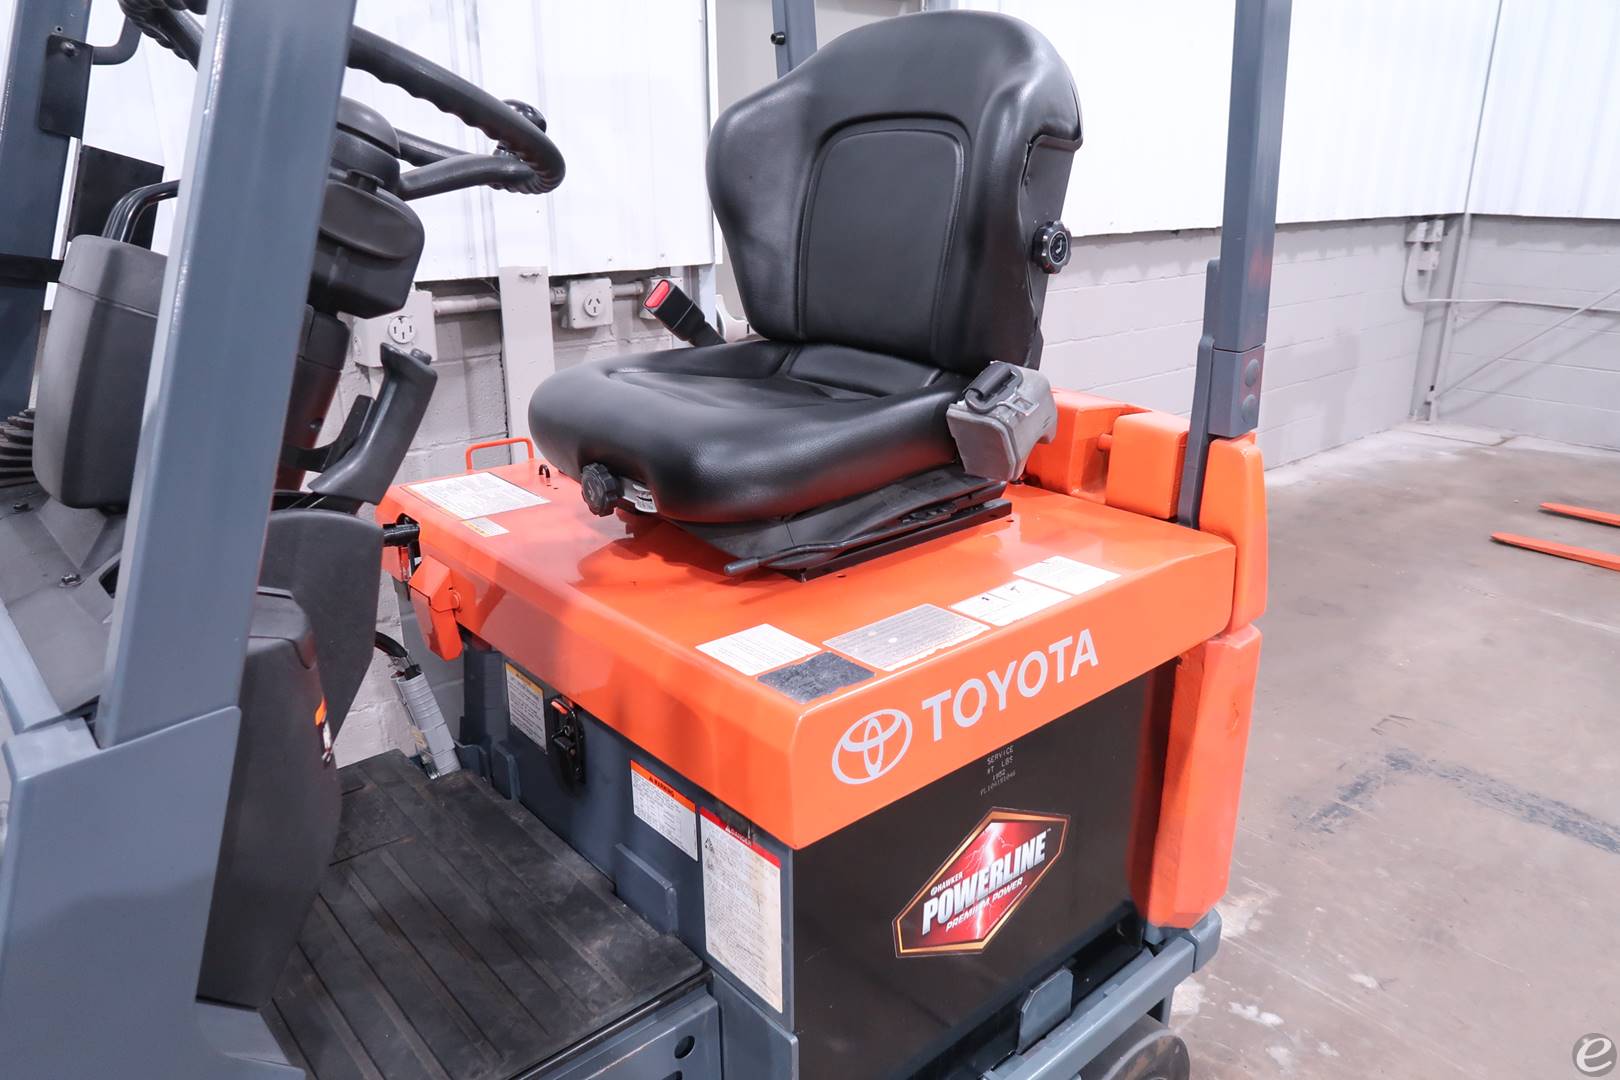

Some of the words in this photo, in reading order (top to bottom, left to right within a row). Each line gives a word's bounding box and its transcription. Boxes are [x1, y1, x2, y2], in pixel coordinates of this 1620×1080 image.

[922, 628, 1099, 742] TOYOTA
[986, 745, 1015, 765] SERVICE
[922, 831, 1048, 936] POWERLINE
[937, 871, 964, 892] HAWKER
[992, 876, 1024, 904] POWER
